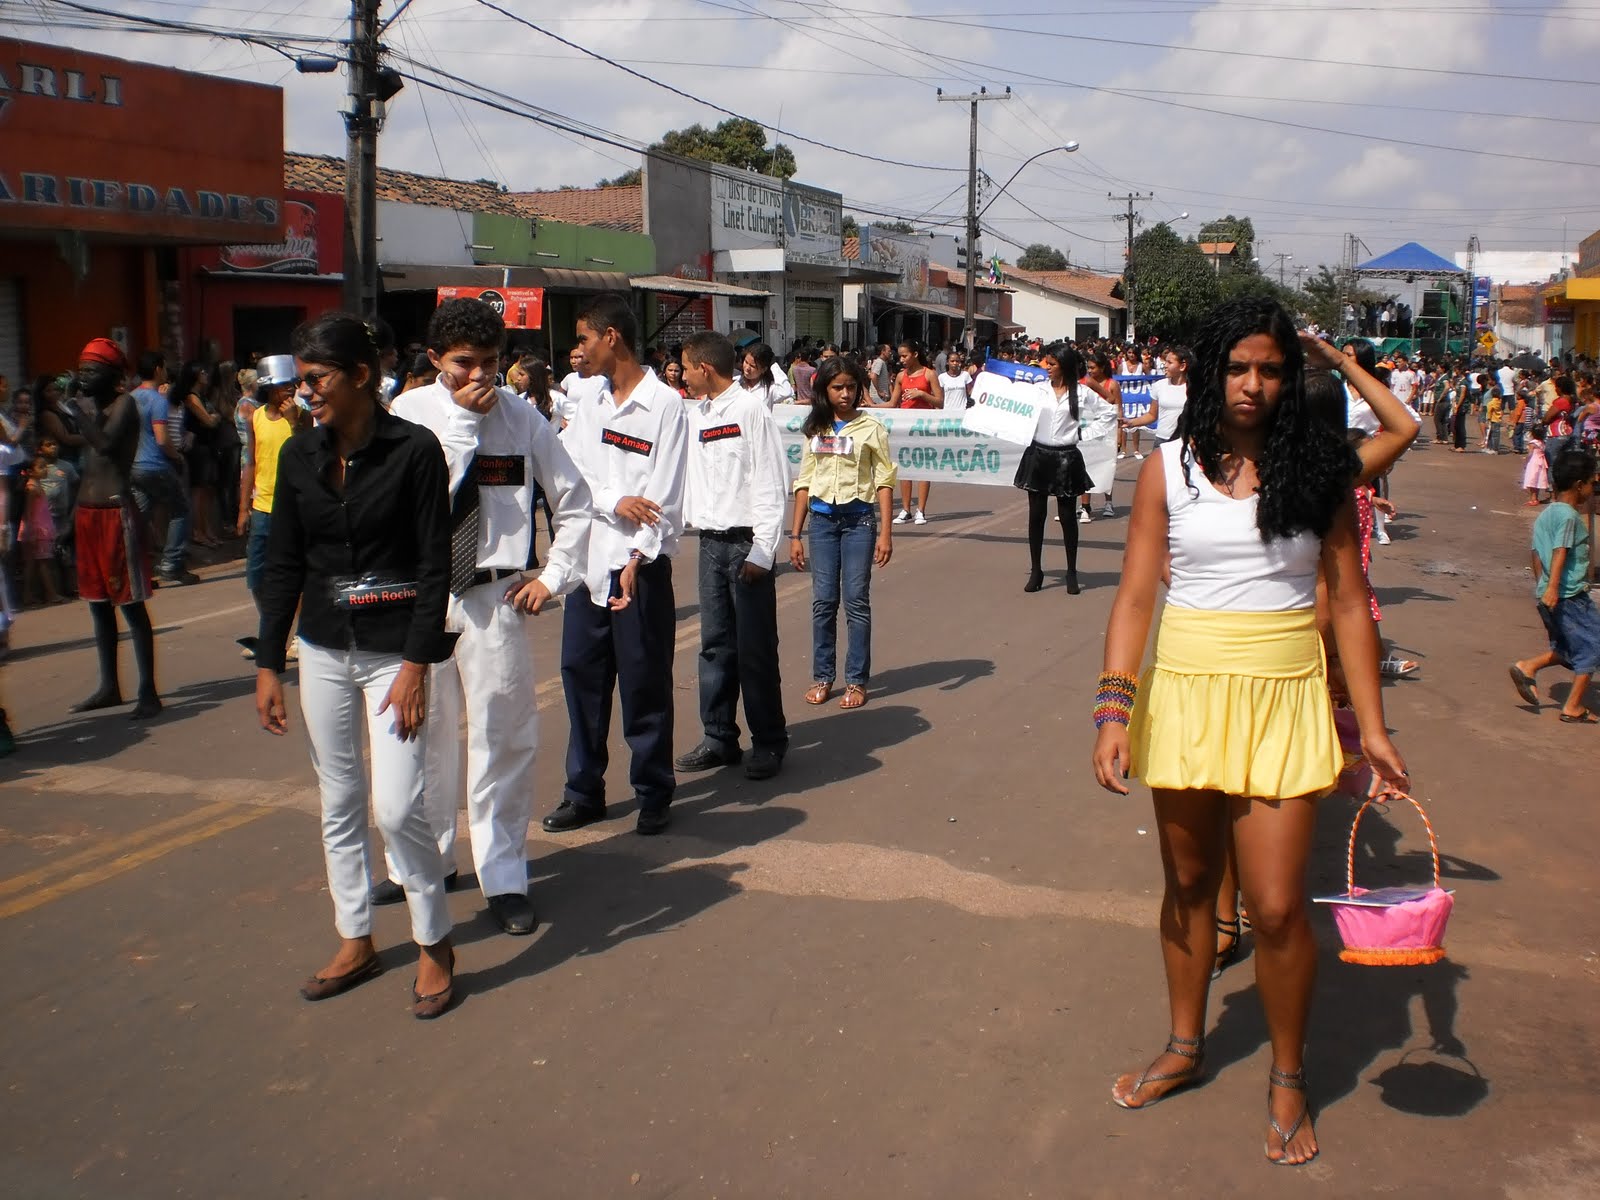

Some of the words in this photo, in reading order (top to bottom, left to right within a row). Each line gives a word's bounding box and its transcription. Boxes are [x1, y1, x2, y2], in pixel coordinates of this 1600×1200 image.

[723, 201, 745, 231] Linet
[979, 391, 1034, 418] OBSERVAR
[604, 431, 621, 443] Jorge
[622, 437, 650, 451] Amado
[703, 429, 721, 439] Castro
[722, 426, 740, 435] Alves
[898, 443, 1000, 478] CORAÇÃO
[349, 592, 378, 605] Ruth
[381, 588, 417, 602] Rocha
